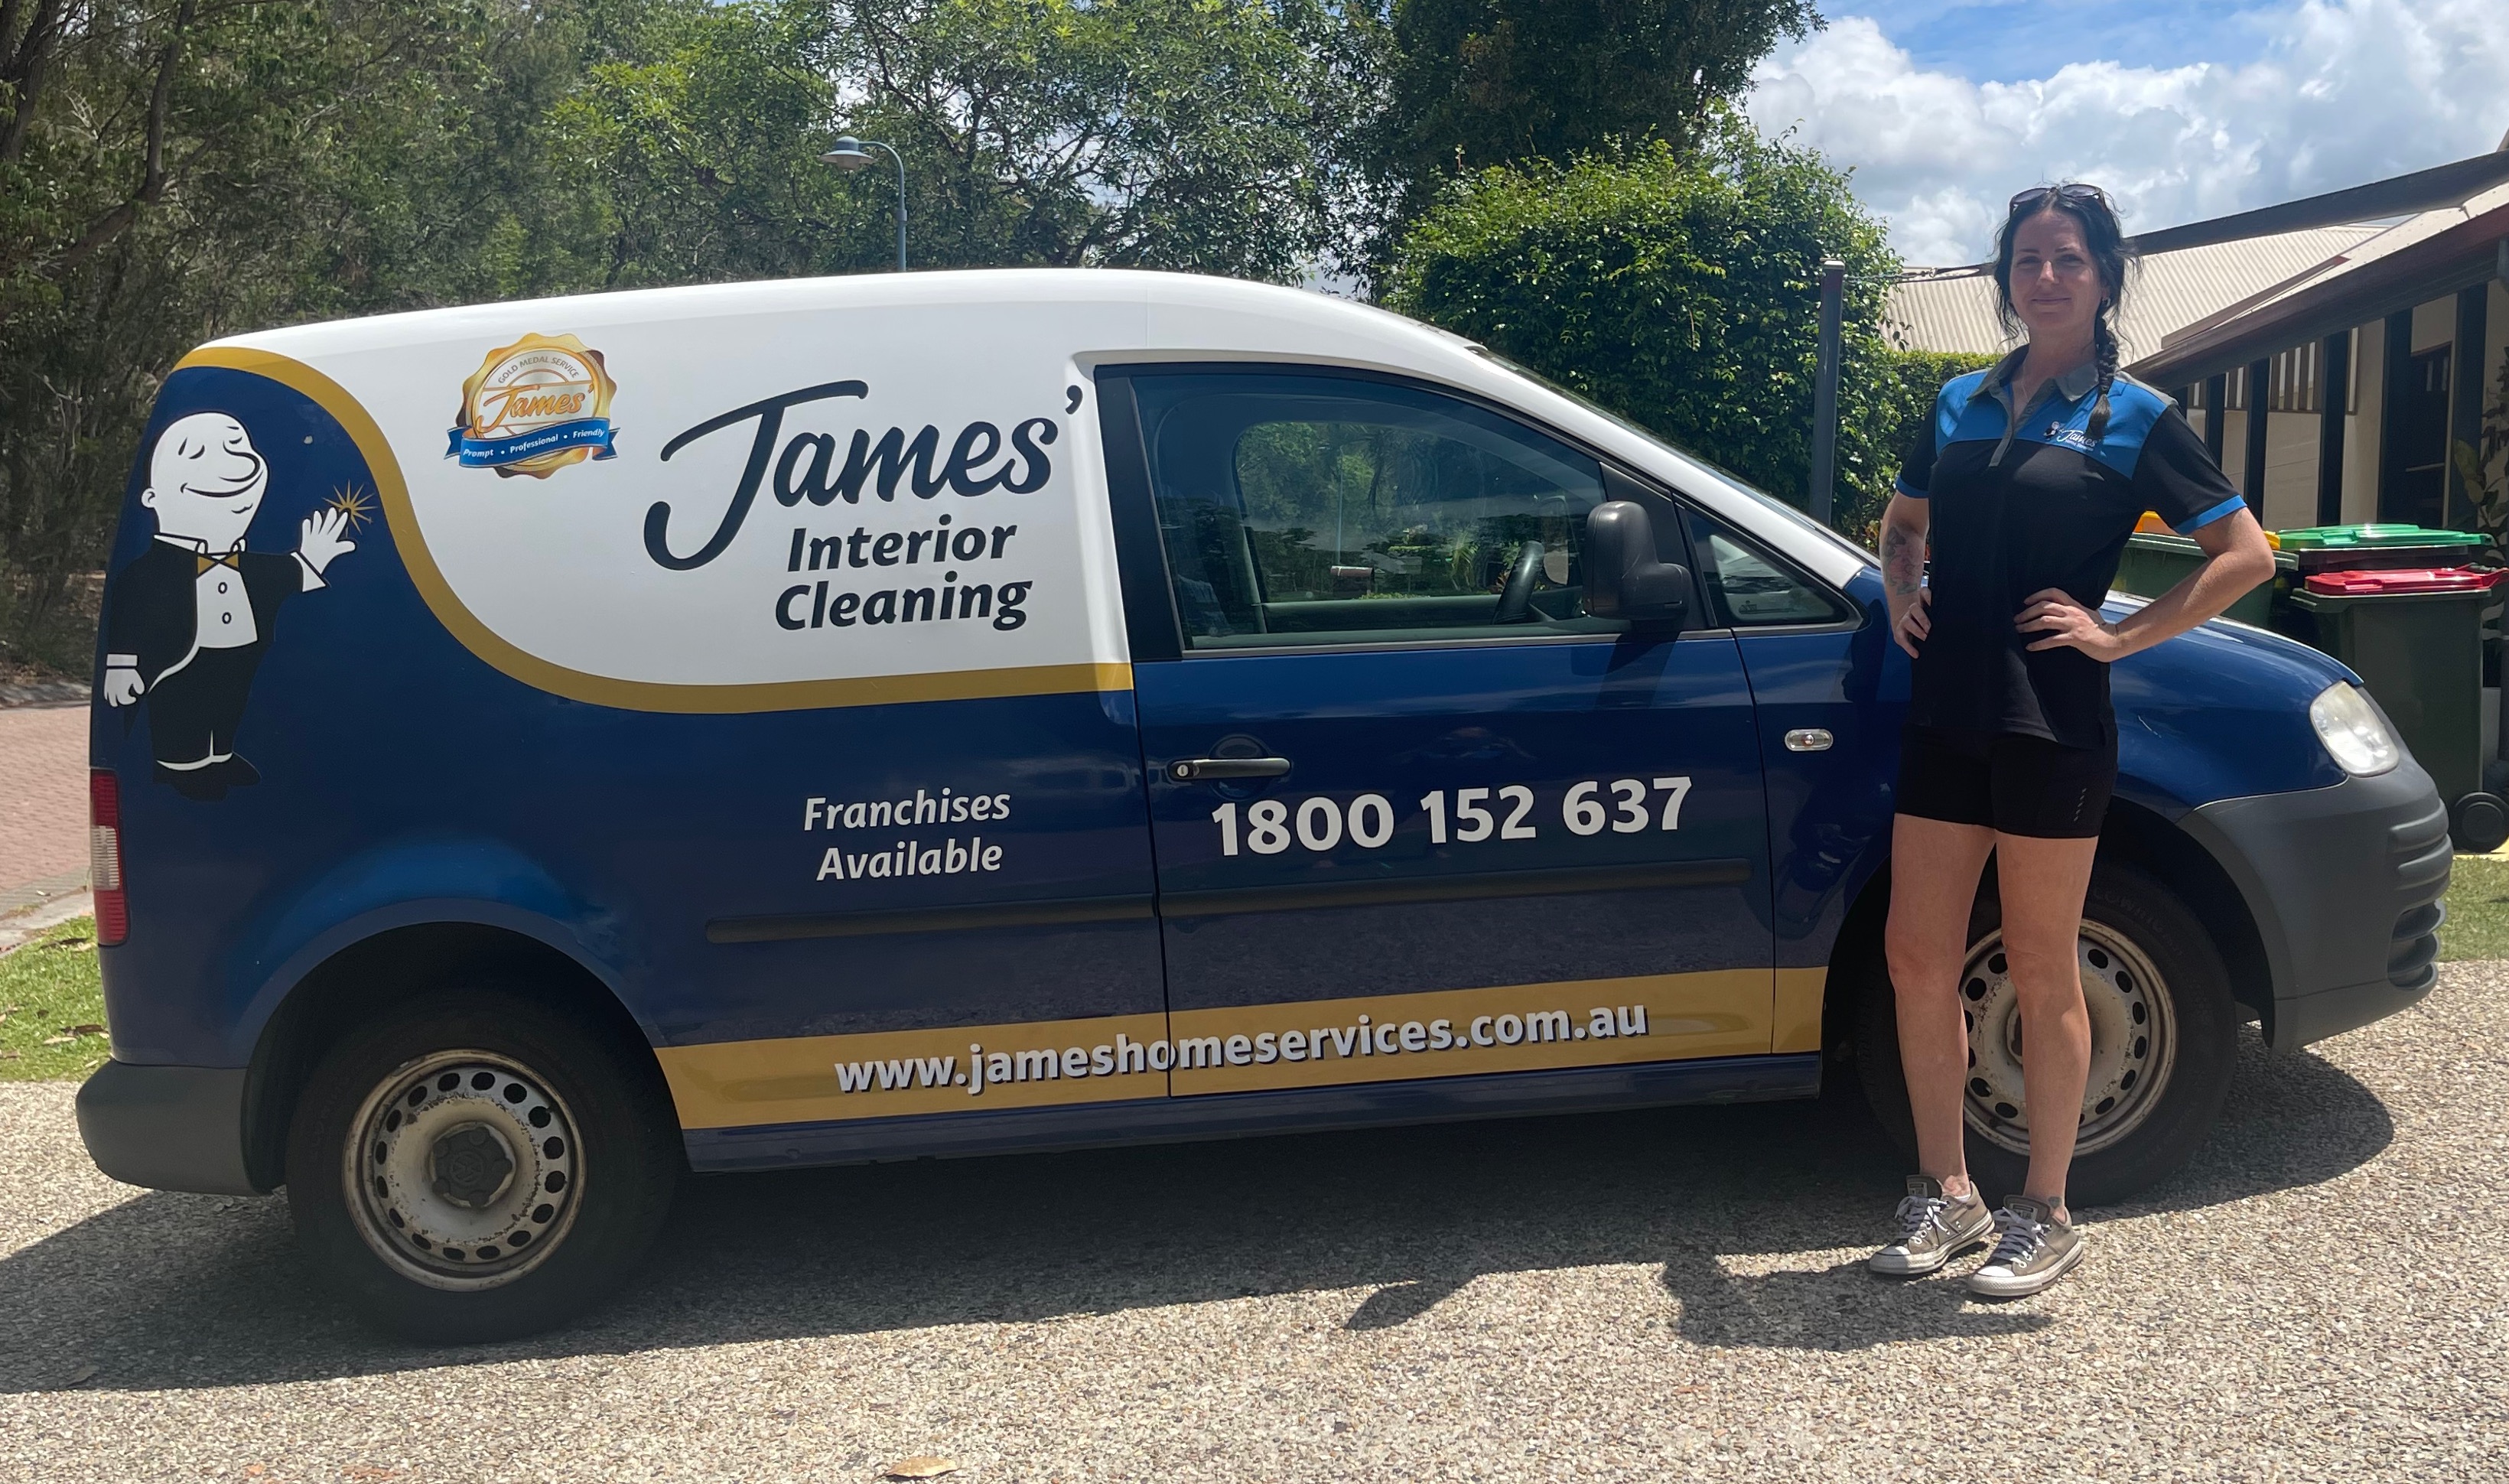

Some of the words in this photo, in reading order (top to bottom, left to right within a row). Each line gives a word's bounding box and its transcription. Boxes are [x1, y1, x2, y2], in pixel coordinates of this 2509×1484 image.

[498, 364, 519, 383] GOLD
[519, 356, 549, 368] MEDAL
[551, 356, 580, 379] SERVICE
[463, 448, 494, 459] Prompt
[509, 434, 559, 454] Professional
[573, 428, 605, 438] Friendly
[644, 380, 1083, 571] James'
[787, 513, 1017, 572] Interior
[775, 571, 1033, 631] Cleaning
[804, 787, 1011, 831] Franchises
[1212, 794, 1394, 856] 1800
[1420, 785, 1536, 844] 152
[1563, 776, 1692, 835] 637
[815, 837, 1004, 881] Available
[835, 1004, 1648, 1095] www.jameshomeservices.com.au
